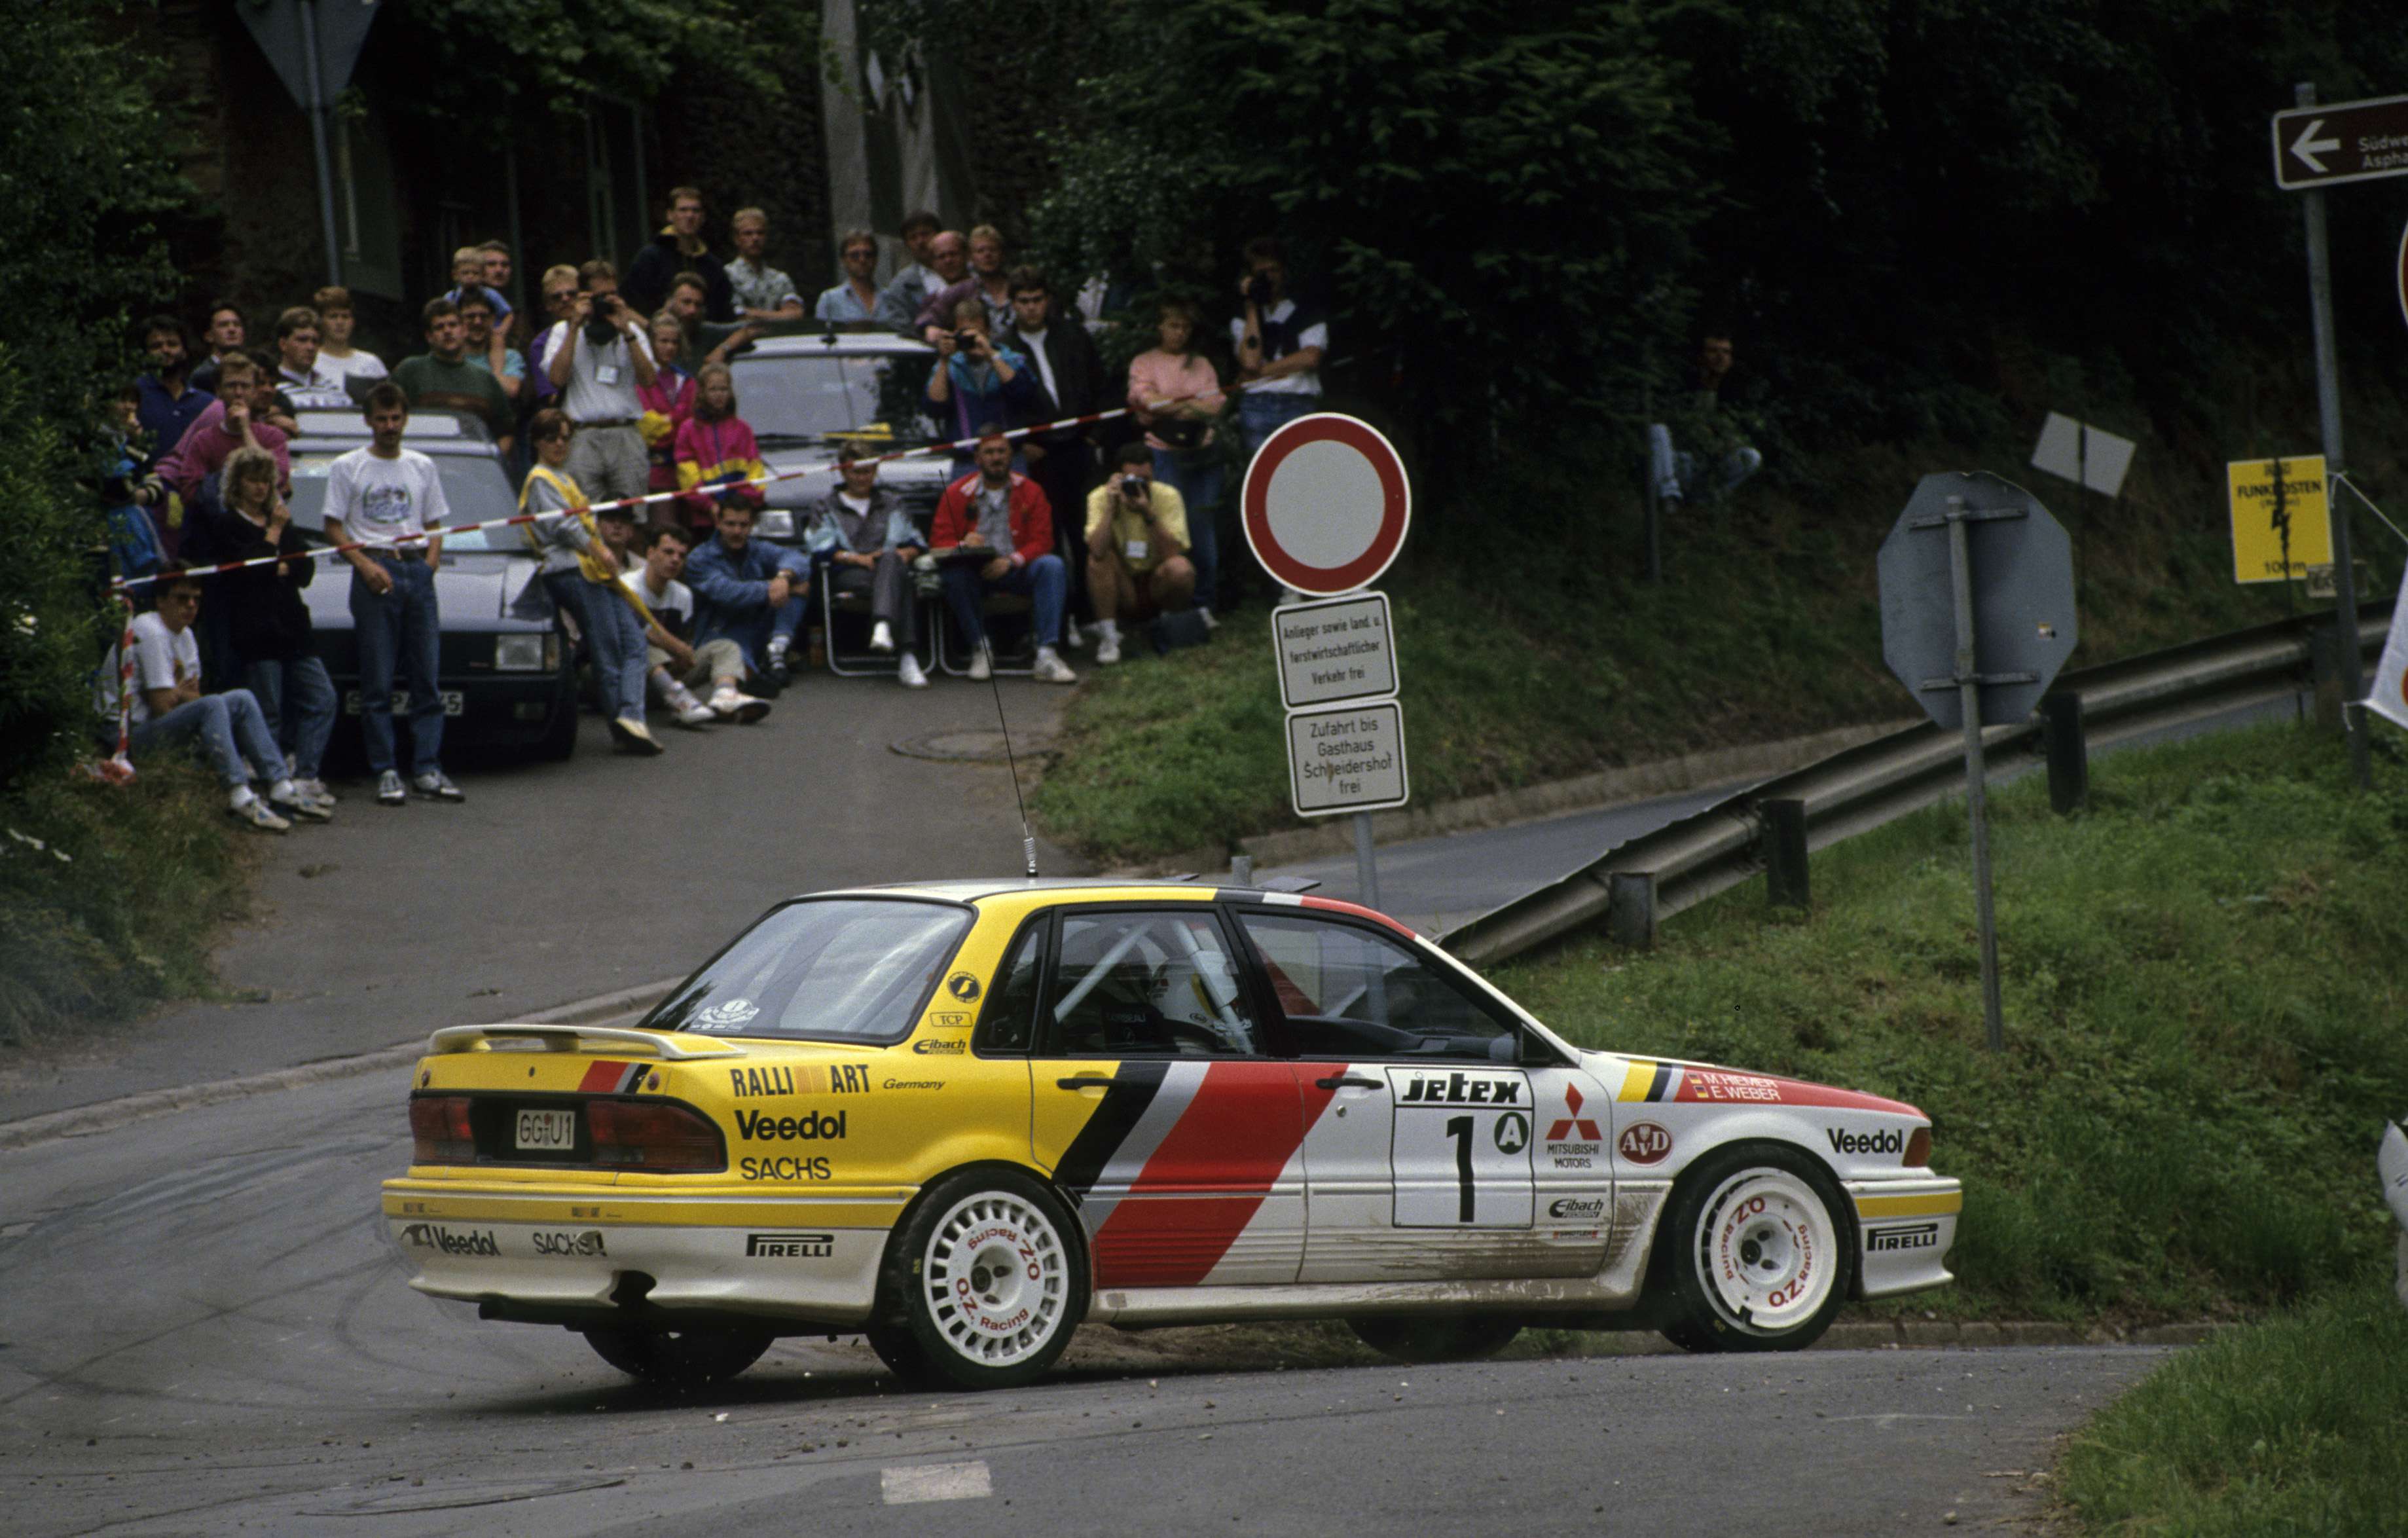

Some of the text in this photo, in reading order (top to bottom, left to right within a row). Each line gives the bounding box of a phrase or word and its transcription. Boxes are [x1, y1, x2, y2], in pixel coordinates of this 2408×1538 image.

[2237, 480, 2322, 498] FUNKOSTEN
[1284, 625, 1319, 640] Anlieger
[1323, 619, 1347, 634] sowie
[1311, 665, 1365, 685] Verkehr frei
[1311, 717, 1378, 738] Zufahrt bis
[1317, 739, 1374, 756] Gasthaus
[1304, 752, 1392, 778] Scheidershof
[1339, 778, 1361, 794] frei
[939, 1016, 962, 1025] TCP
[913, 1038, 966, 1055] Eibach
[883, 1078, 945, 1091] Germany
[1402, 1071, 1520, 1104] jetex
[734, 1110, 846, 1140] Veedol
[1547, 1144, 1599, 1155] MITSUBISHI
[1827, 1128, 1903, 1154] Veedol
[740, 1157, 831, 1180] SACHS
[1446, 1116, 1474, 1222] 1
[1555, 1158, 1592, 1168] MOTORS
[1549, 1199, 1603, 1218] Eibach
[431, 1226, 502, 1256] Veedol
[746, 1234, 833, 1256] PIRELLI
[968, 1228, 1017, 1250] Racing
[1867, 1223, 1938, 1251] PIRELLI
[1721, 1224, 1734, 1279] Racing
[1798, 1224, 1812, 1281] Racing
[980, 1308, 1029, 1330] Racing
